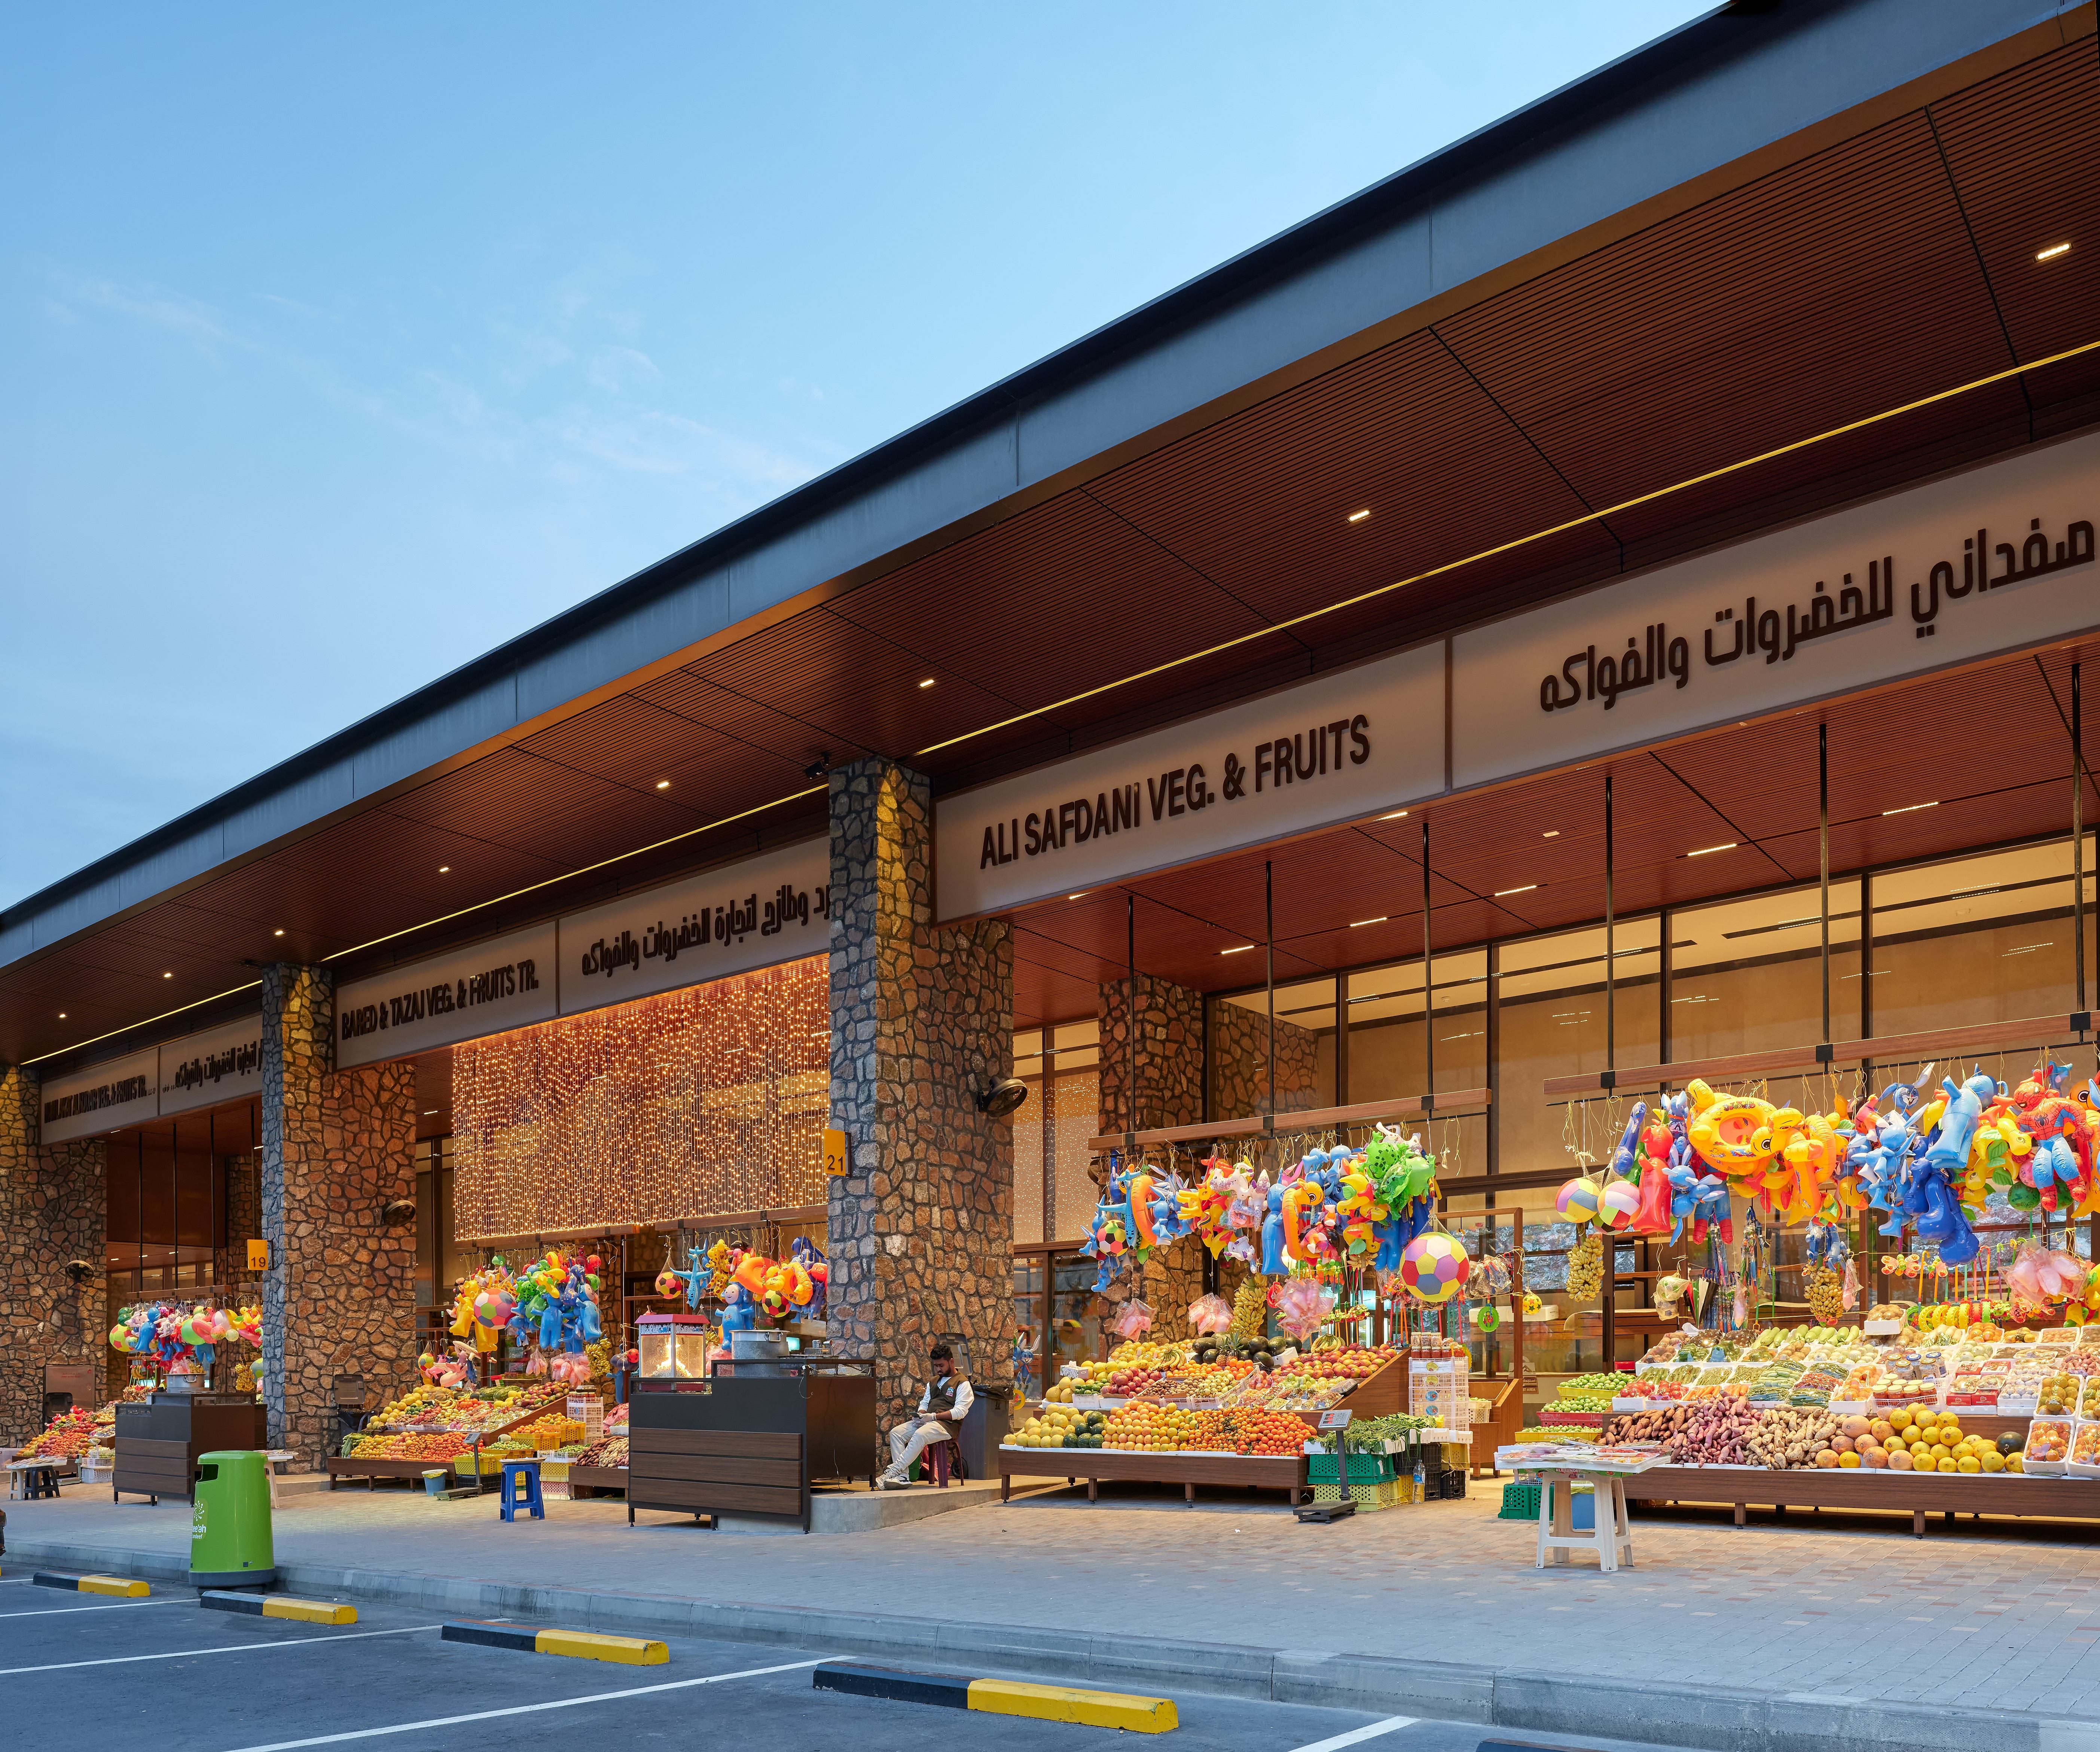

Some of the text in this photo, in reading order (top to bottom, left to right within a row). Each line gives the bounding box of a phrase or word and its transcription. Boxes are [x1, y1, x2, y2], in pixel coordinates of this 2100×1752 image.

[1540, 518, 2095, 712] صفداني للخضروات والفواكه
[980, 714, 1370, 869] ALI SAFDANI VEG. & FRUITS
[643, 907, 710, 962] الخضروات
[715, 894, 756, 947] لتجارة
[761, 885, 808, 936] وطازج
[582, 931, 639, 978] والفواكه
[342, 959, 539, 1040] BARED & TAZAJ VEG. & FRUITS TR.
[116, 1076, 137, 1104] FRUITS
[137, 1074, 147, 1097] TR.
[827, 1155, 843, 1171] 21
[251, 1256, 266, 1267] 19
